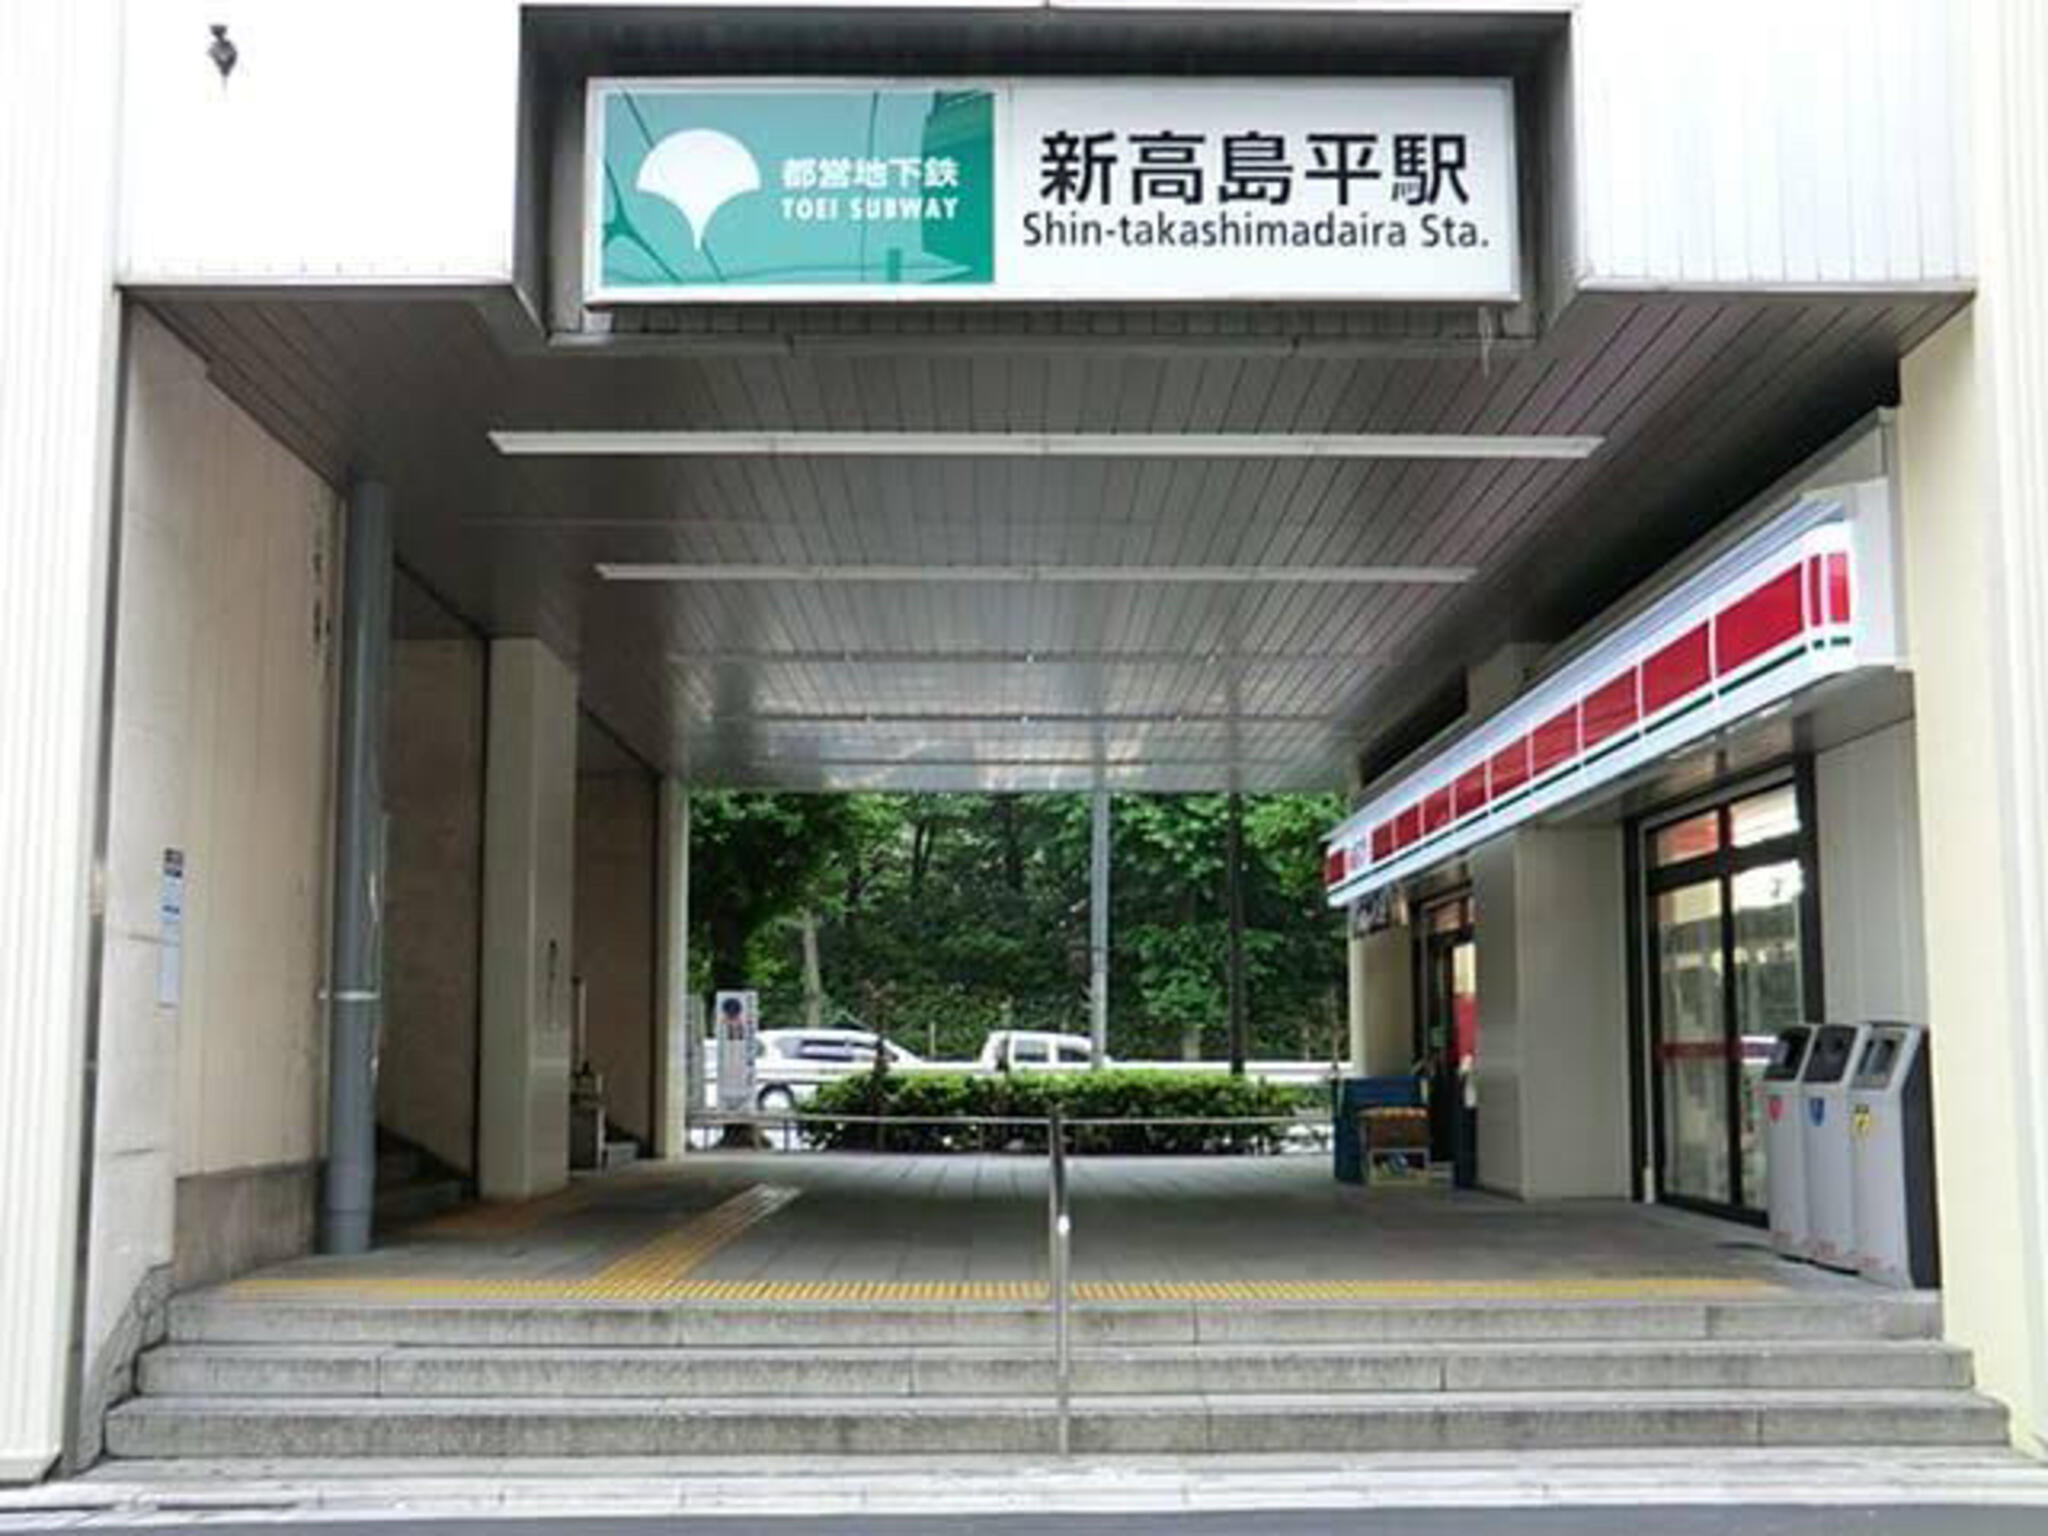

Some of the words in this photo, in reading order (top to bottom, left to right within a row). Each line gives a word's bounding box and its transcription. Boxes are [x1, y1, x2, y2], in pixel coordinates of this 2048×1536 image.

[782, 156, 960, 189] 都営地下鉄
[1040, 130, 1470, 206] 新高島平駅
[781, 197, 838, 220] TOEI
[849, 197, 959, 220] SUBWAY
[1023, 210, 1407, 247] Shin-takashimadaira
[1420, 212, 1489, 247] Sta.
